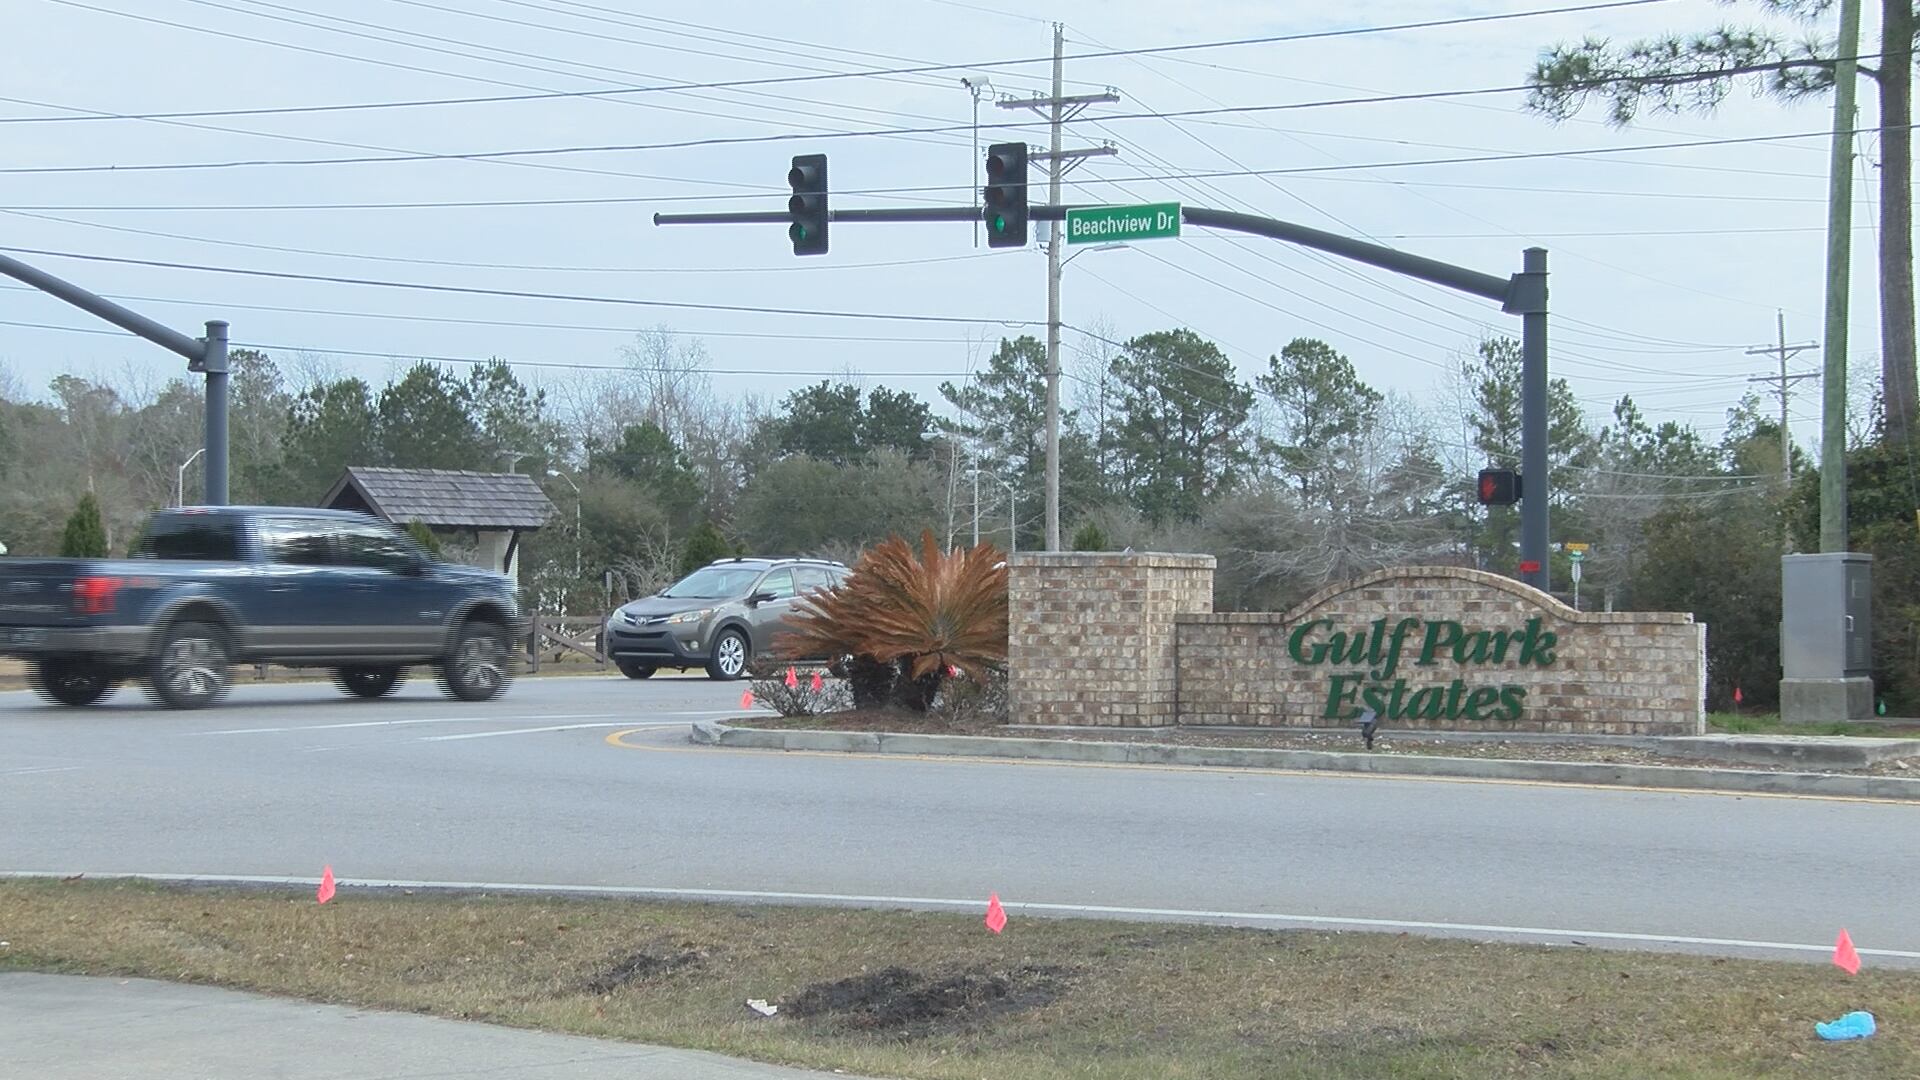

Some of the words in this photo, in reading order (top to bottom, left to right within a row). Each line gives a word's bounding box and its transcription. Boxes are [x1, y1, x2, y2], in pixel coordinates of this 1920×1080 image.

[1073, 214, 1152, 236] Beachview
[1157, 211, 1174, 231] Dr
[1288, 617, 1420, 681] Gulf
[1414, 617, 1558, 667] Park
[1322, 672, 1527, 721] Estates
